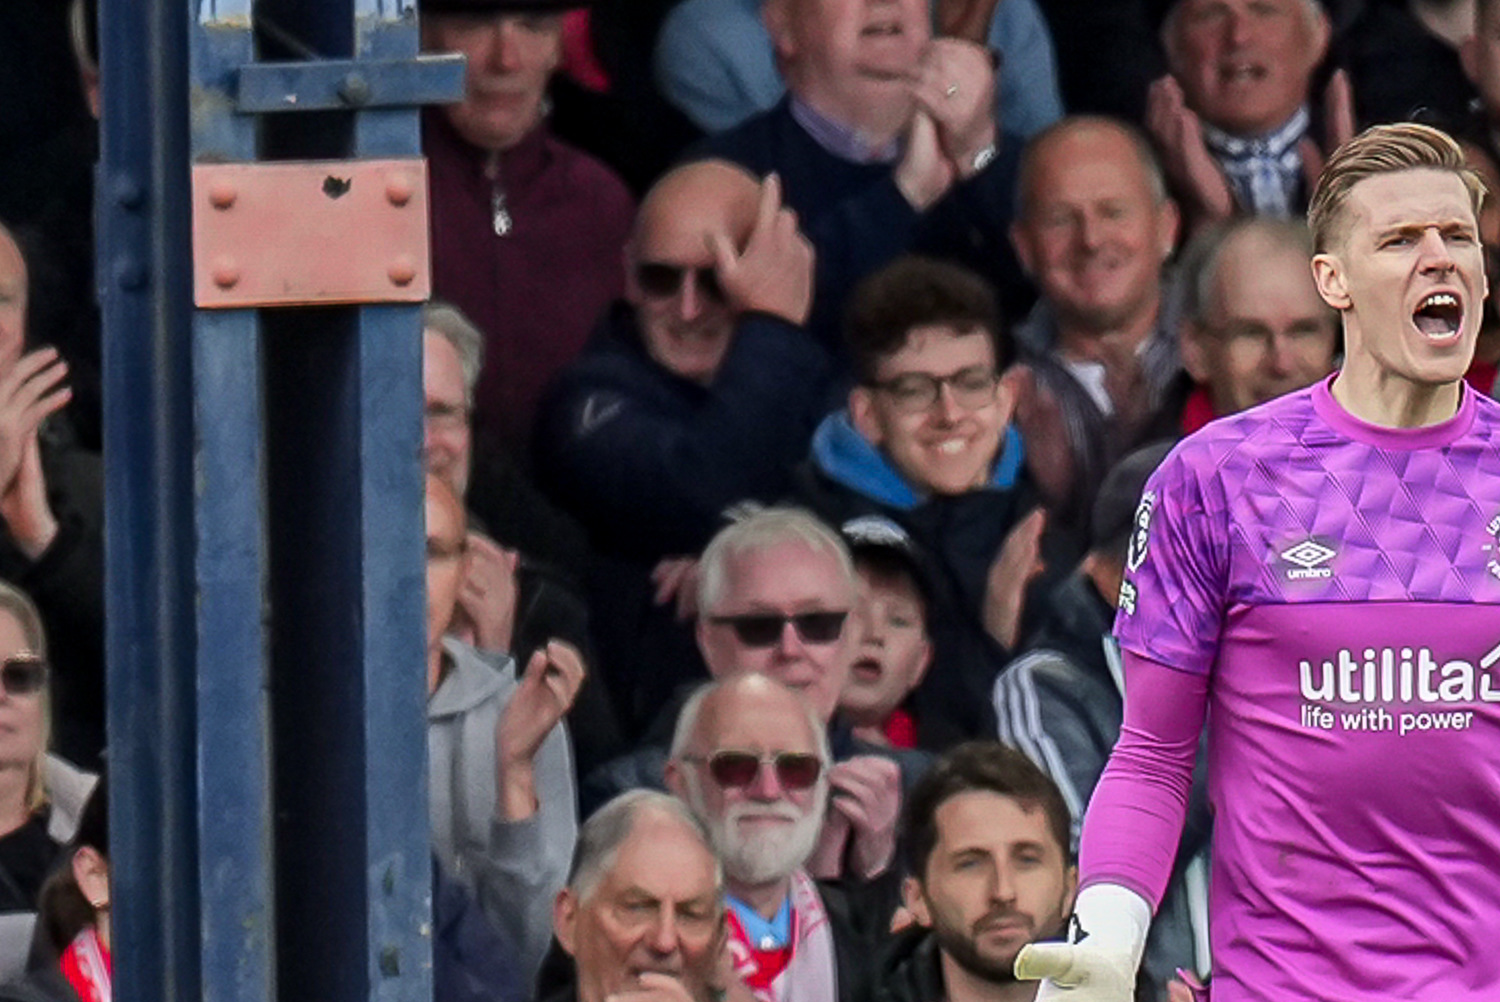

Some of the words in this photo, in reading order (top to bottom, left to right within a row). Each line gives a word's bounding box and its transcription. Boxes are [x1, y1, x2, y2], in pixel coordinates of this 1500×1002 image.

[1287, 568, 1331, 579] umbro
[1299, 648, 1475, 702] utilita
[1301, 705, 1334, 728] life
[1341, 708, 1393, 730] with
[1400, 711, 1473, 736] power
